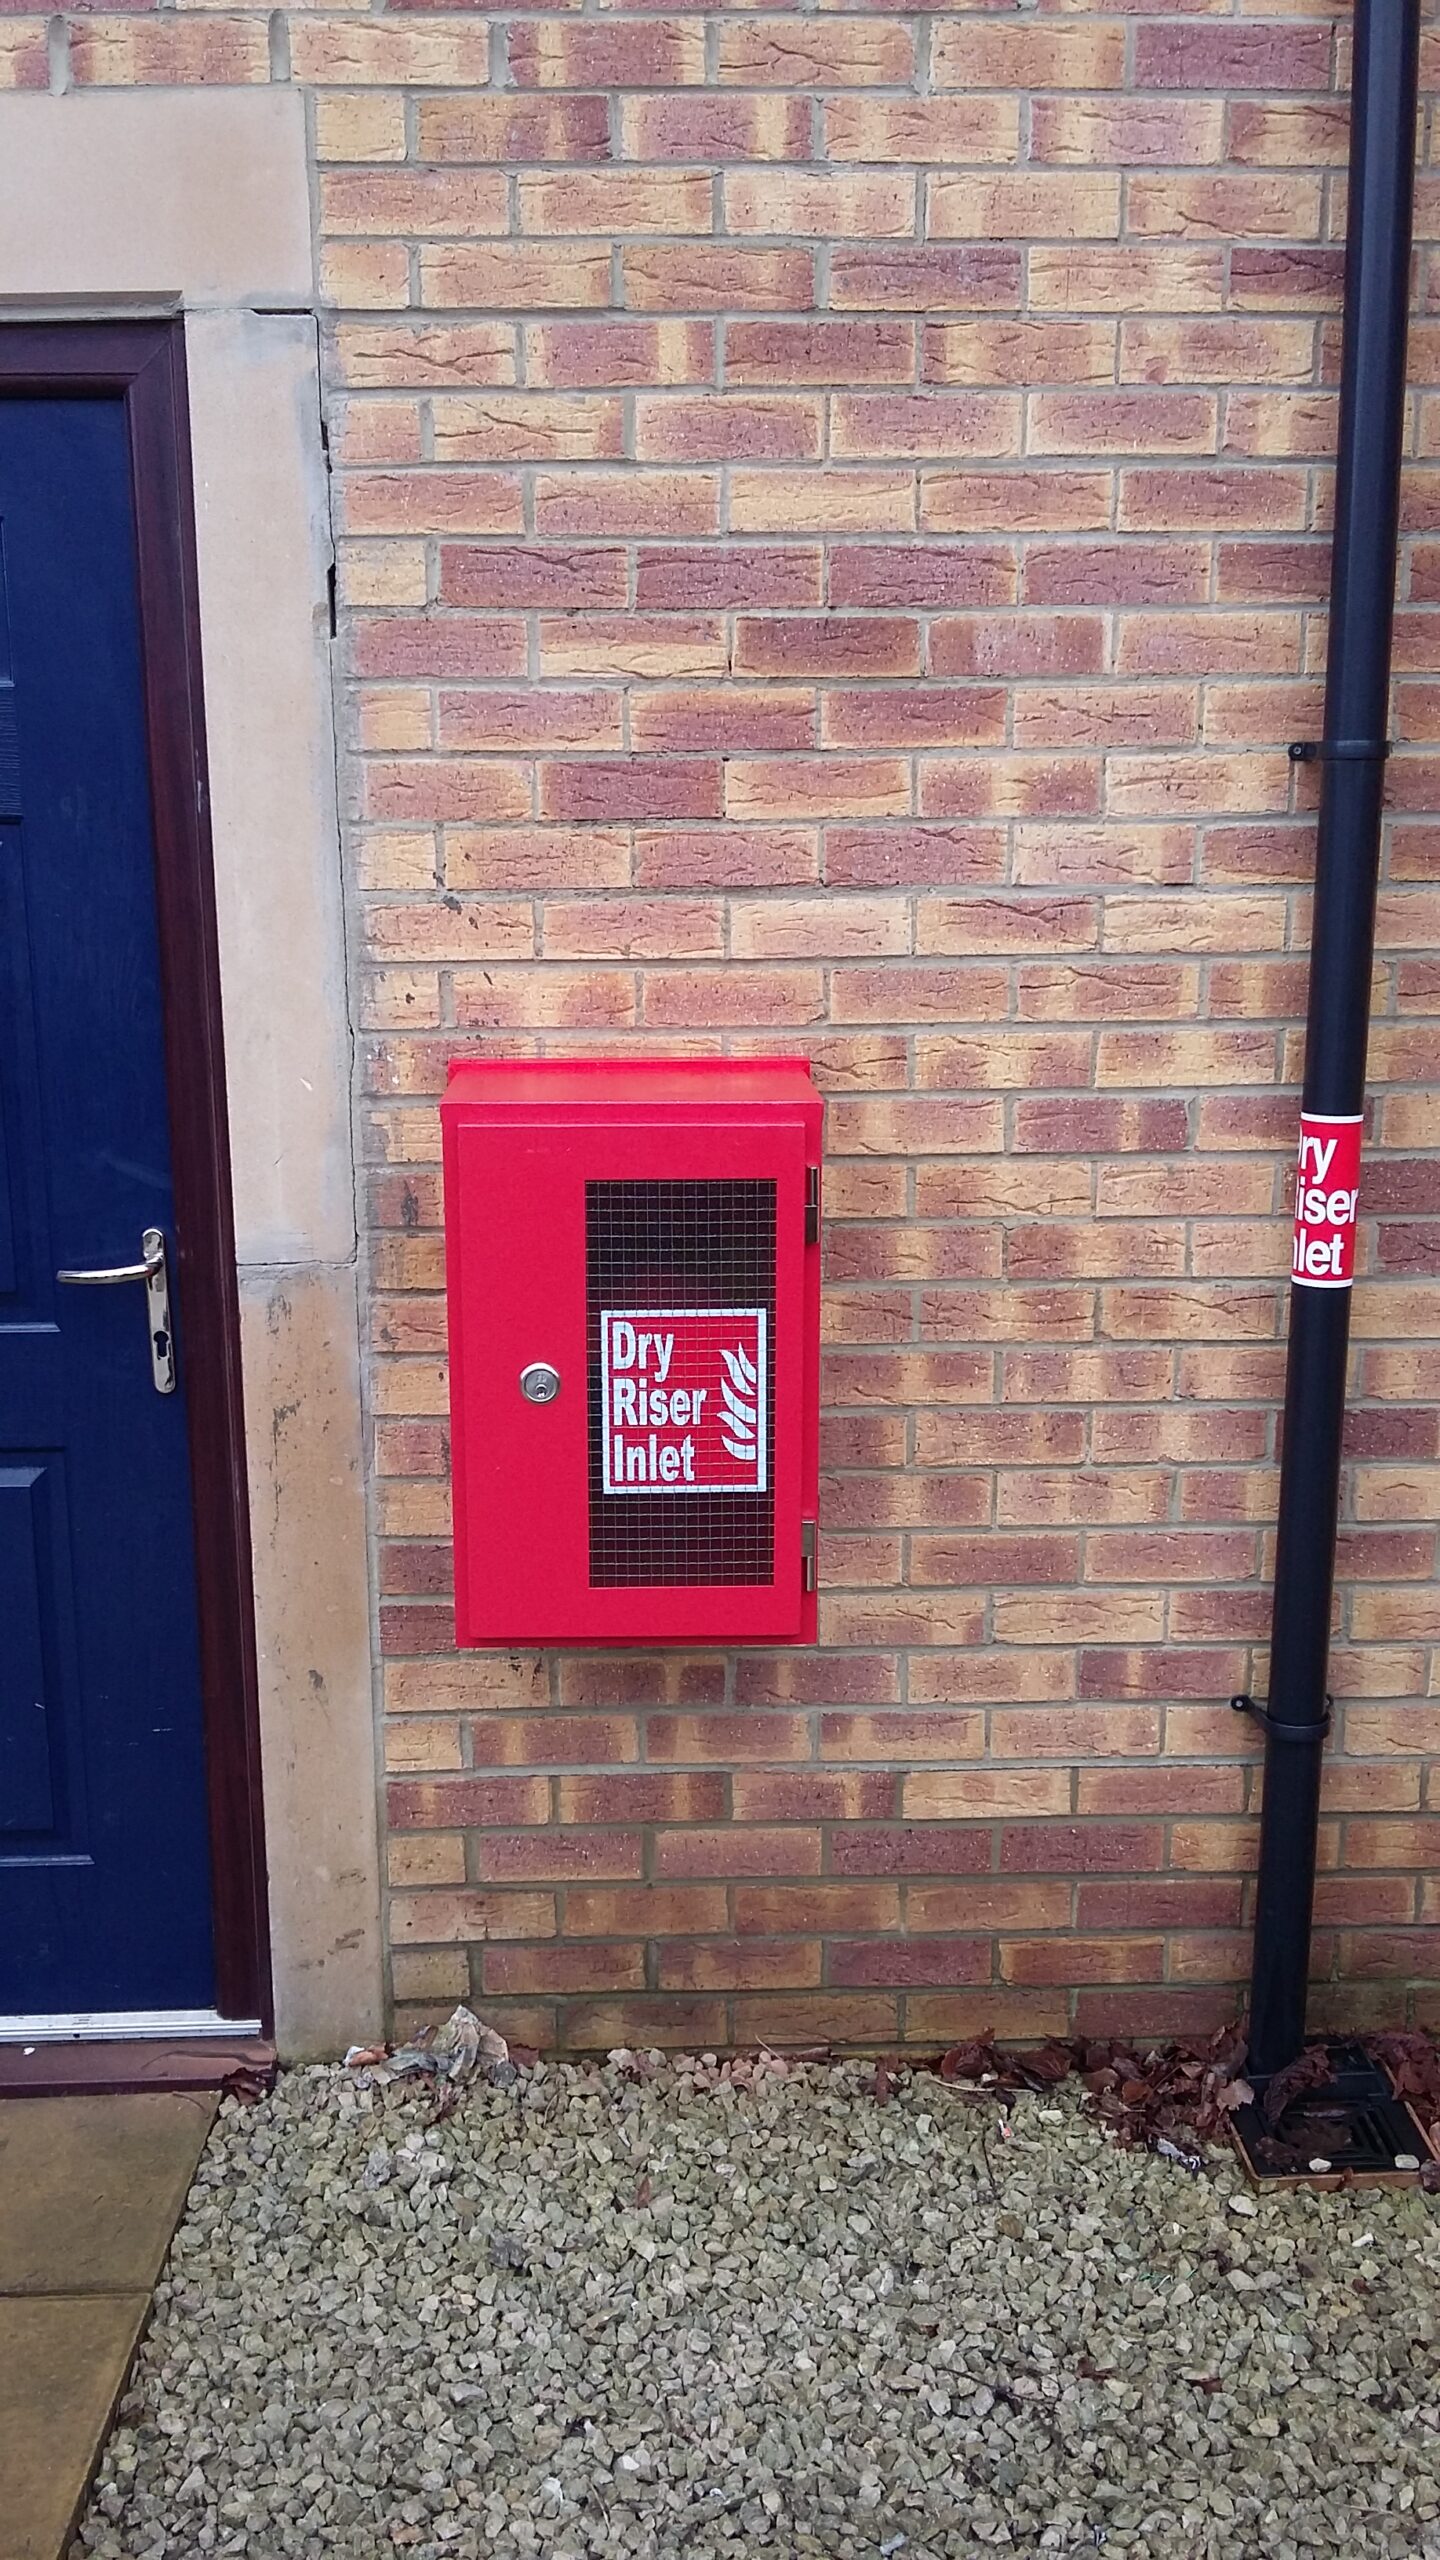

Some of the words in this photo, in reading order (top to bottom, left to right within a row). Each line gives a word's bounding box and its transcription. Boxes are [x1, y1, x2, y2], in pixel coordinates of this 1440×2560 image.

[1298, 1123, 1338, 1185] ry
[1294, 1175, 1359, 1226] iser
[1292, 1227, 1345, 1277] let
[611, 1320, 674, 1383] Dry
[612, 1377, 708, 1426] Riser
[613, 1433, 696, 1482] Inlet
